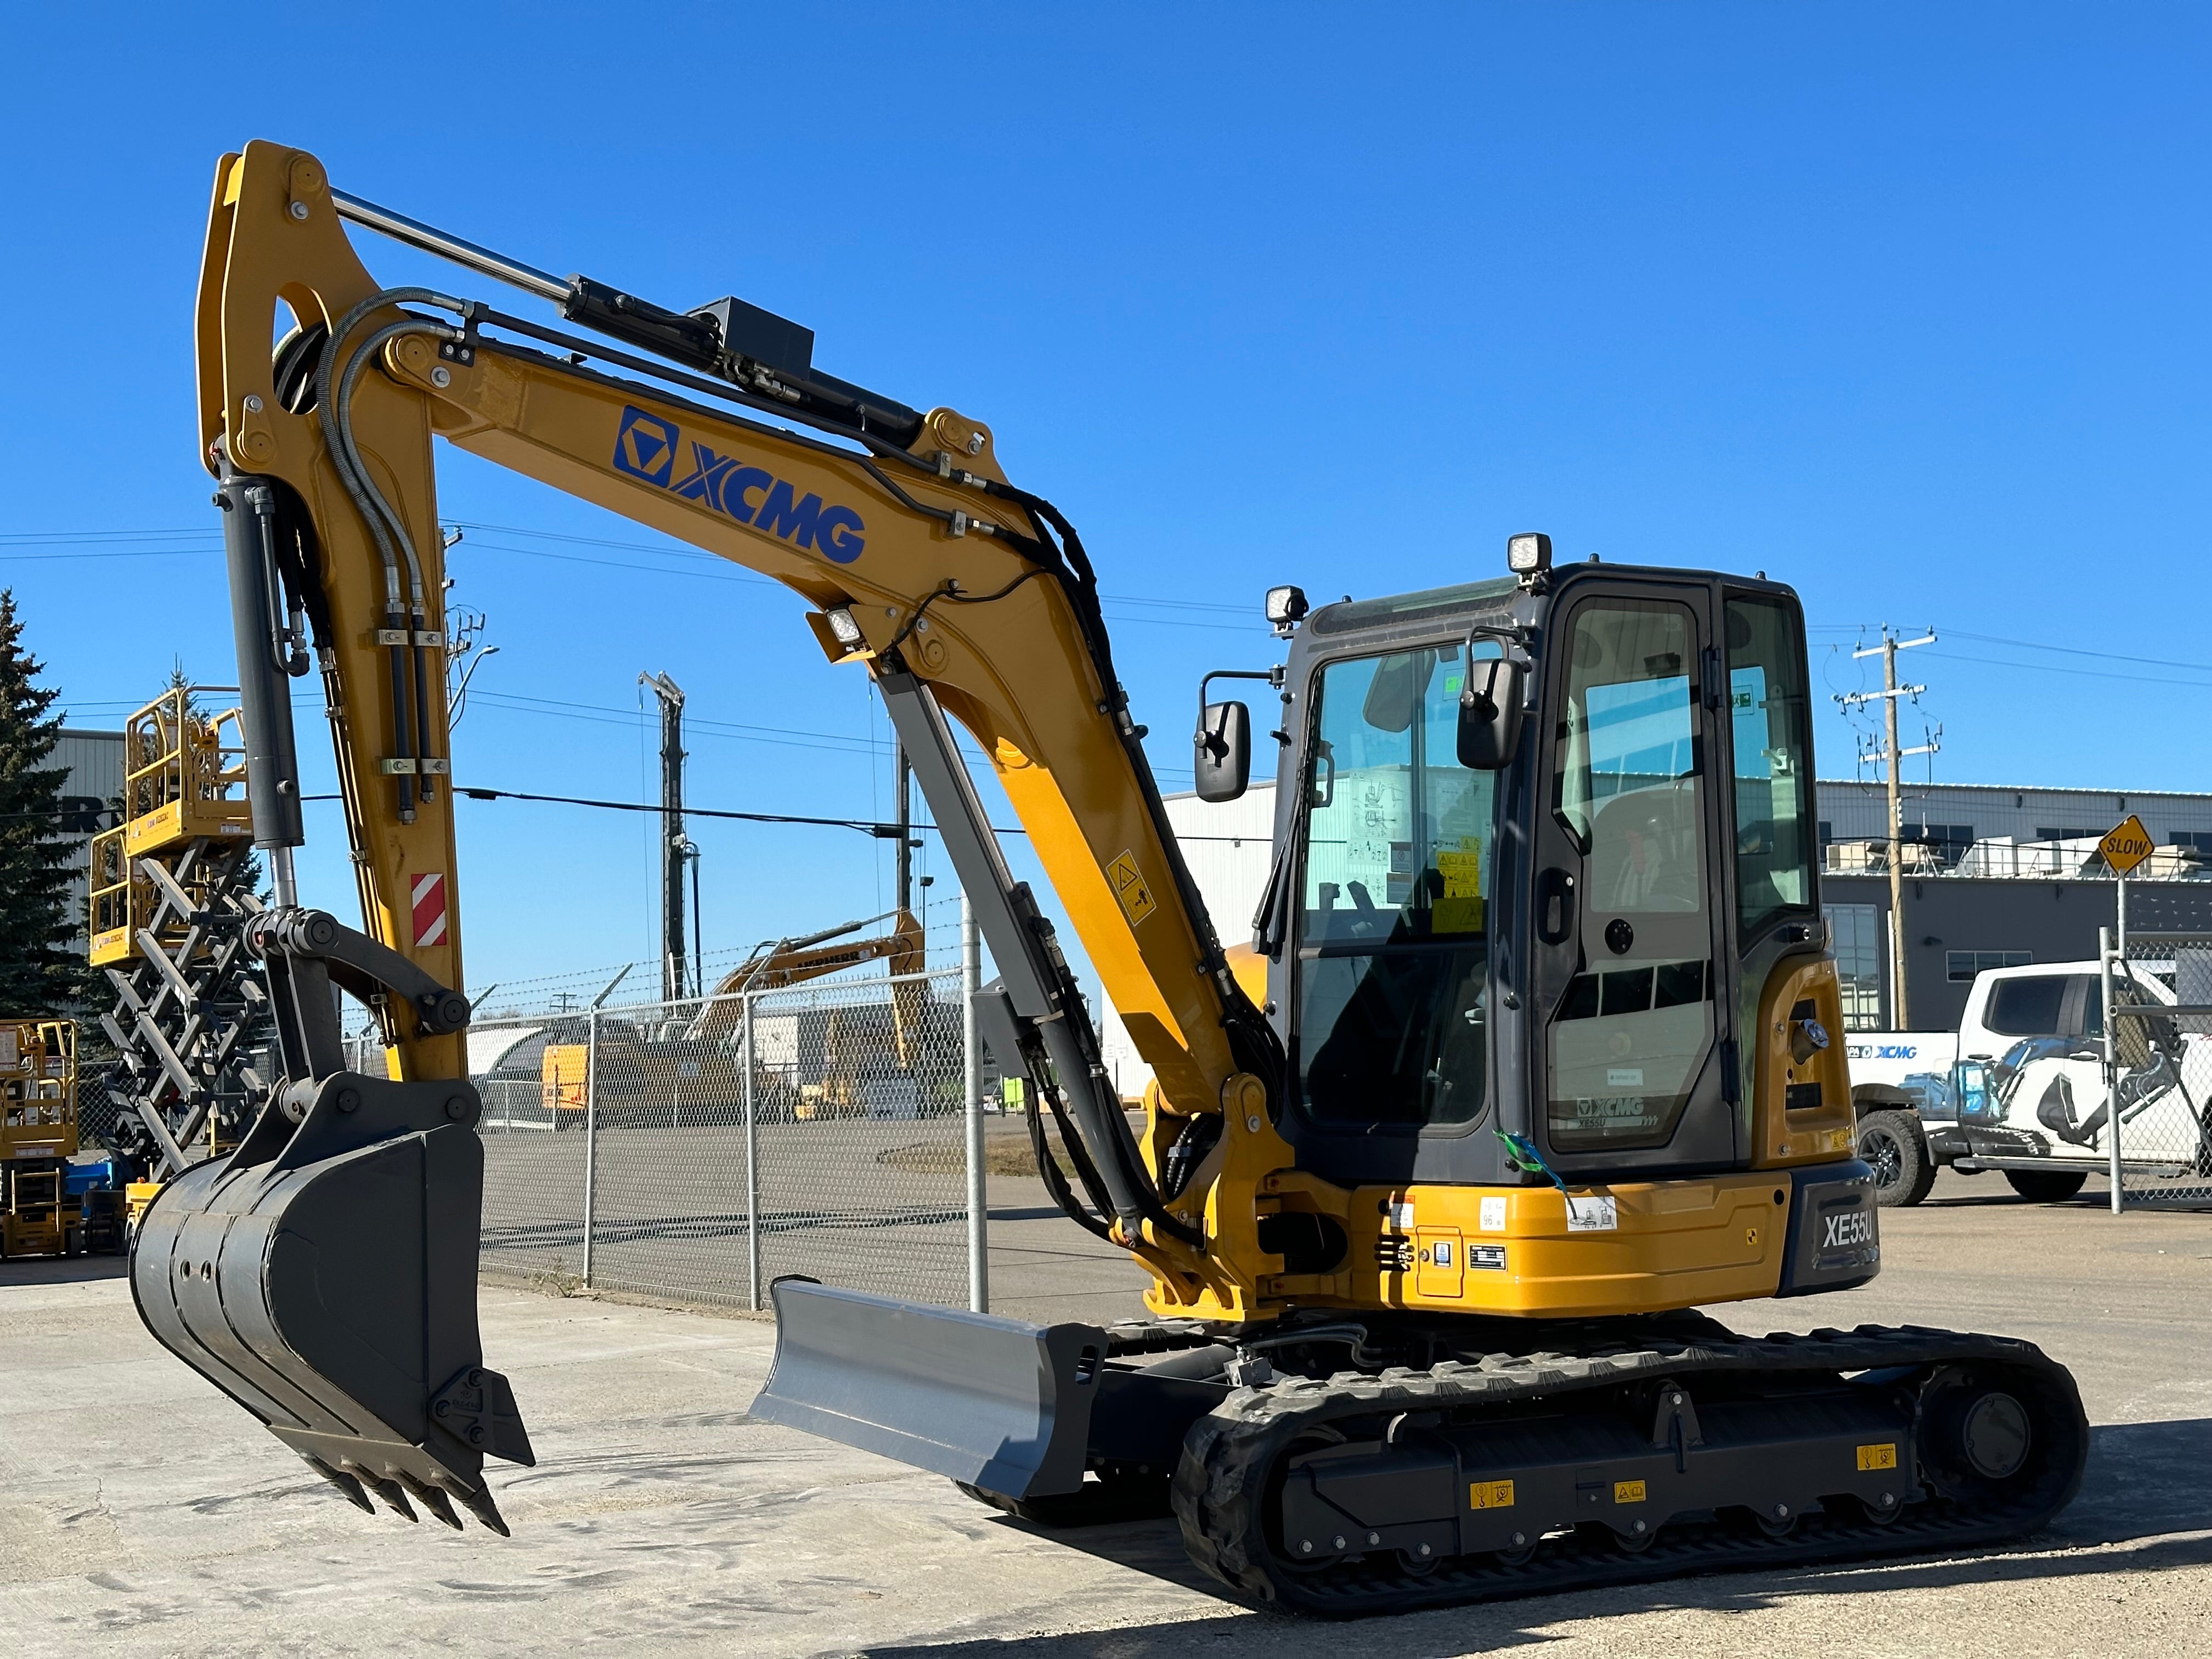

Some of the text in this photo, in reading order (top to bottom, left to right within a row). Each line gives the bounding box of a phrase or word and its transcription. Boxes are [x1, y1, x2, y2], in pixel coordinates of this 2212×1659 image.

[669, 441, 865, 564] XCMG
[2106, 837, 2148, 856] SLOW
[1874, 1045, 1917, 1059] XCMG
[1592, 1097, 1644, 1116] XCMG
[1579, 1118, 1606, 1128] XE55U
[1483, 1214, 1493, 1226] 96
[1822, 1210, 1872, 1248] XE55U
